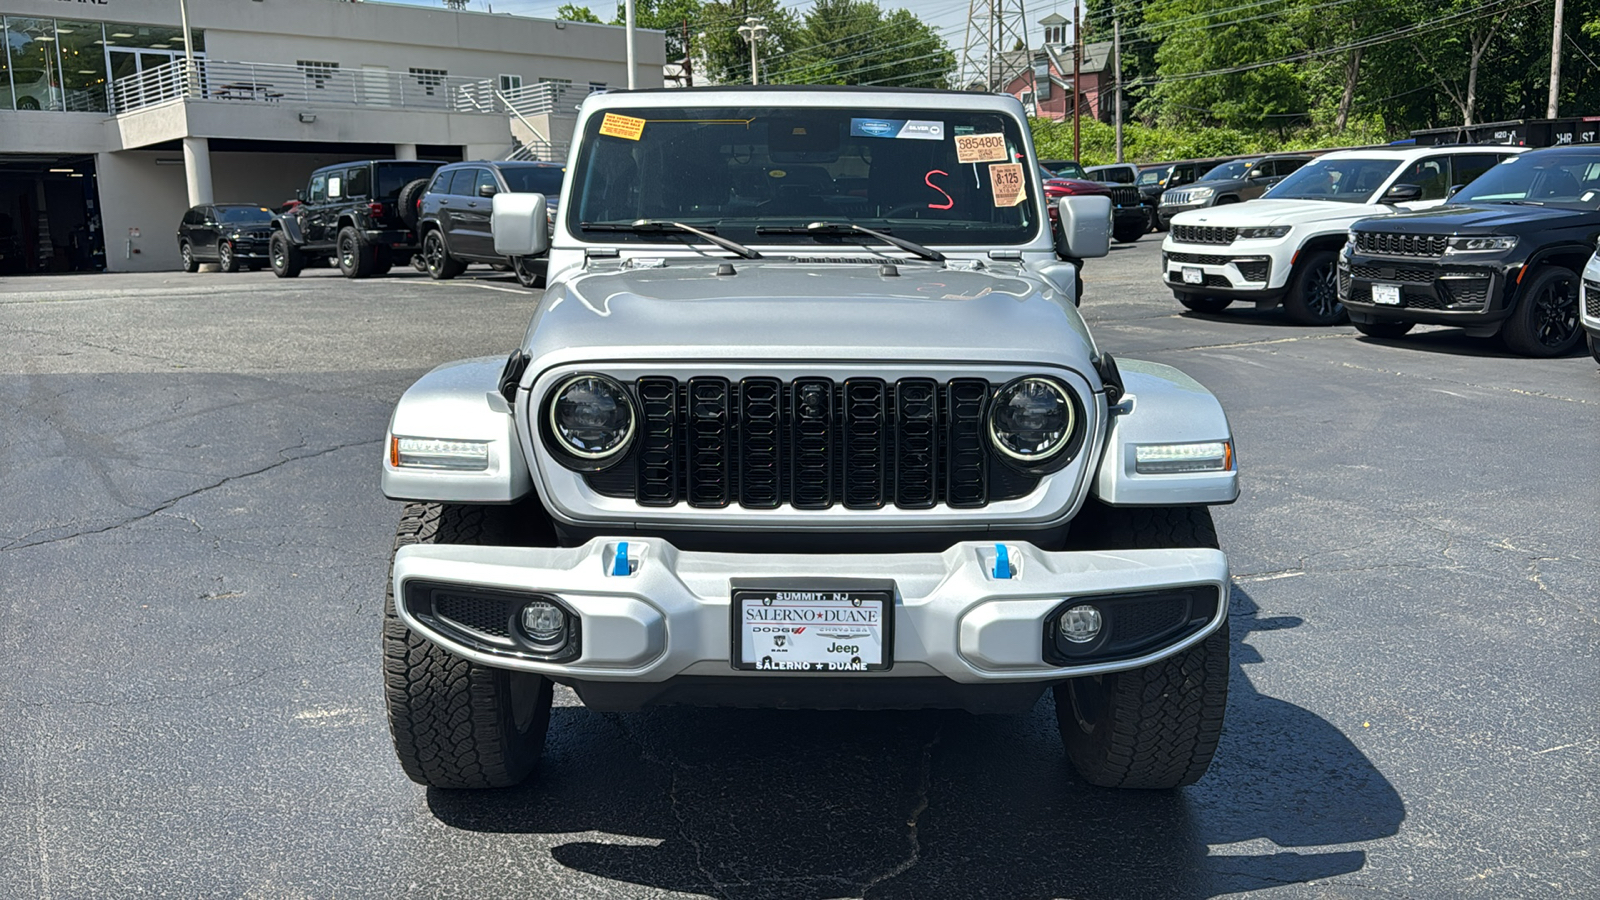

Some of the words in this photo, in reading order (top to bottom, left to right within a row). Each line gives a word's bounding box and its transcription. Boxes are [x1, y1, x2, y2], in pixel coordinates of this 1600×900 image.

[924, 169, 954, 210] S
[833, 593, 849, 601] NJ
[746, 608, 815, 622] SALERNO
[824, 609, 878, 623] DUANE
[827, 642, 860, 655] Jeep
[755, 661, 811, 671] SALERNO
[828, 662, 868, 671] DUANE
